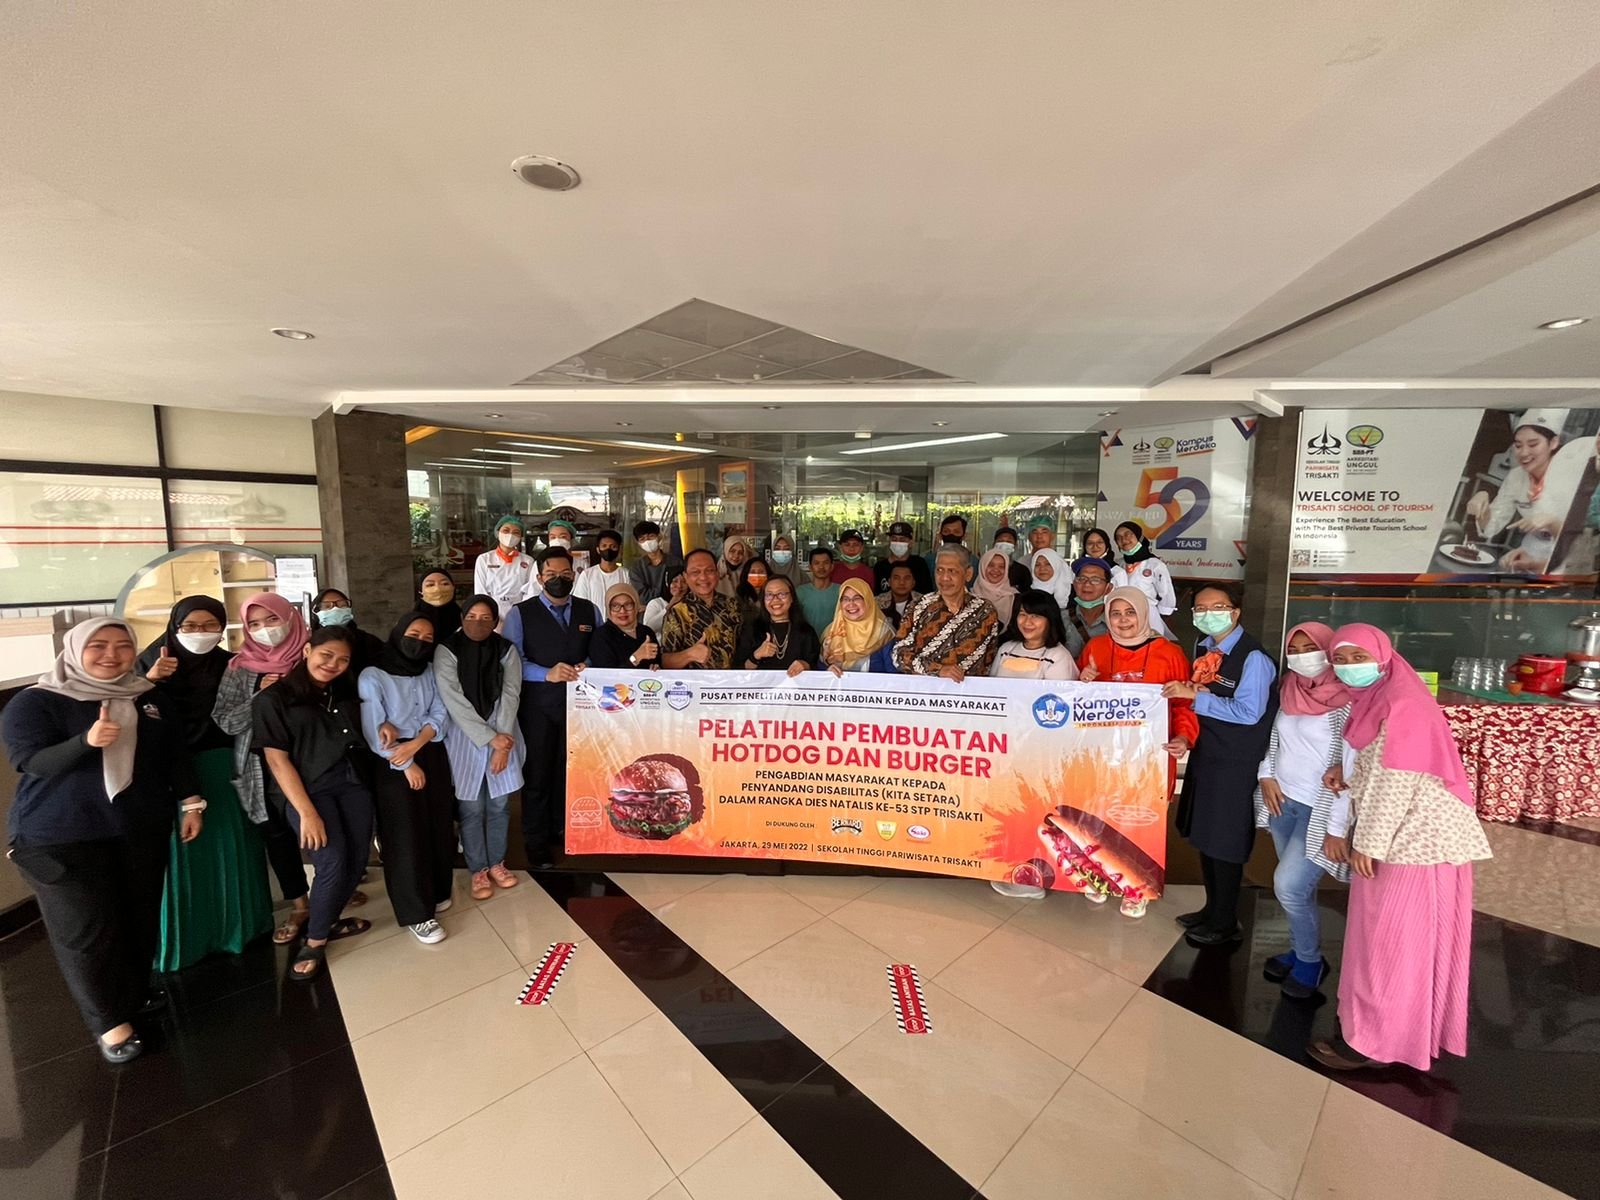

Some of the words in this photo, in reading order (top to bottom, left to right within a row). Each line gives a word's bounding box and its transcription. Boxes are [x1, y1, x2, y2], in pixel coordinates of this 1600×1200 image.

[1176, 435, 1214, 447] Kampus
[1298, 490, 1375, 502] WELCOME
[1379, 490, 1400, 502] TO
[1136, 467, 1211, 549] 52
[1296, 504, 1336, 512] TRISAKTI
[1337, 504, 1375, 512] SCHOOL
[1377, 504, 1390, 512] OF
[1392, 504, 1433, 512] TOURISM
[1175, 540, 1202, 548] YEARS
[701, 692, 733, 700] PUSAT
[736, 692, 792, 701] PENELITIAN
[794, 693, 815, 702] DAN
[818, 693, 883, 704] PENGABDIAN
[885, 696, 926, 706] KEPADA
[929, 699, 1006, 711] MASYARAKAT
[1073, 697, 1141, 711] Kampus
[1073, 708, 1146, 721] Merdeka
[699, 719, 835, 740] PELATIHAN
[842, 723, 1007, 754] PEMBUATAN
[712, 743, 821, 764] HOTDOG
[826, 747, 881, 768] DAN
[887, 750, 991, 778] BURGER
[755, 770, 823, 782] PENGABDIAN
[825, 773, 899, 786] MASYARAKAT
[902, 778, 946, 790] KEPADA
[741, 783, 814, 794] PENYANDANG
[816, 785, 879, 797] DISABILITAS
[881, 789, 910, 801] (KITA
[913, 792, 961, 807] SETARA)
[719, 795, 756, 805] DALAM
[758, 796, 802, 806] RANGKA
[805, 798, 828, 807] DIES
[829, 799, 873, 811] NATALIS
[876, 803, 908, 813] KE-53
[911, 805, 931, 816] STP
[933, 807, 983, 822] TRISAKTI
[720, 840, 760, 850] JAKARTA,
[762, 841, 772, 849] 29
[773, 842, 788, 850] MEI
[789, 843, 808, 851] 2022
[817, 845, 854, 854] SEKOLAH
[856, 847, 885, 857] TINGGI
[886, 850, 939, 863] PARIWISATA
[942, 855, 982, 868] TRISAKTI
[901, 978, 912, 998] ANTRIAN
[906, 1000, 916, 1016] BATAS
